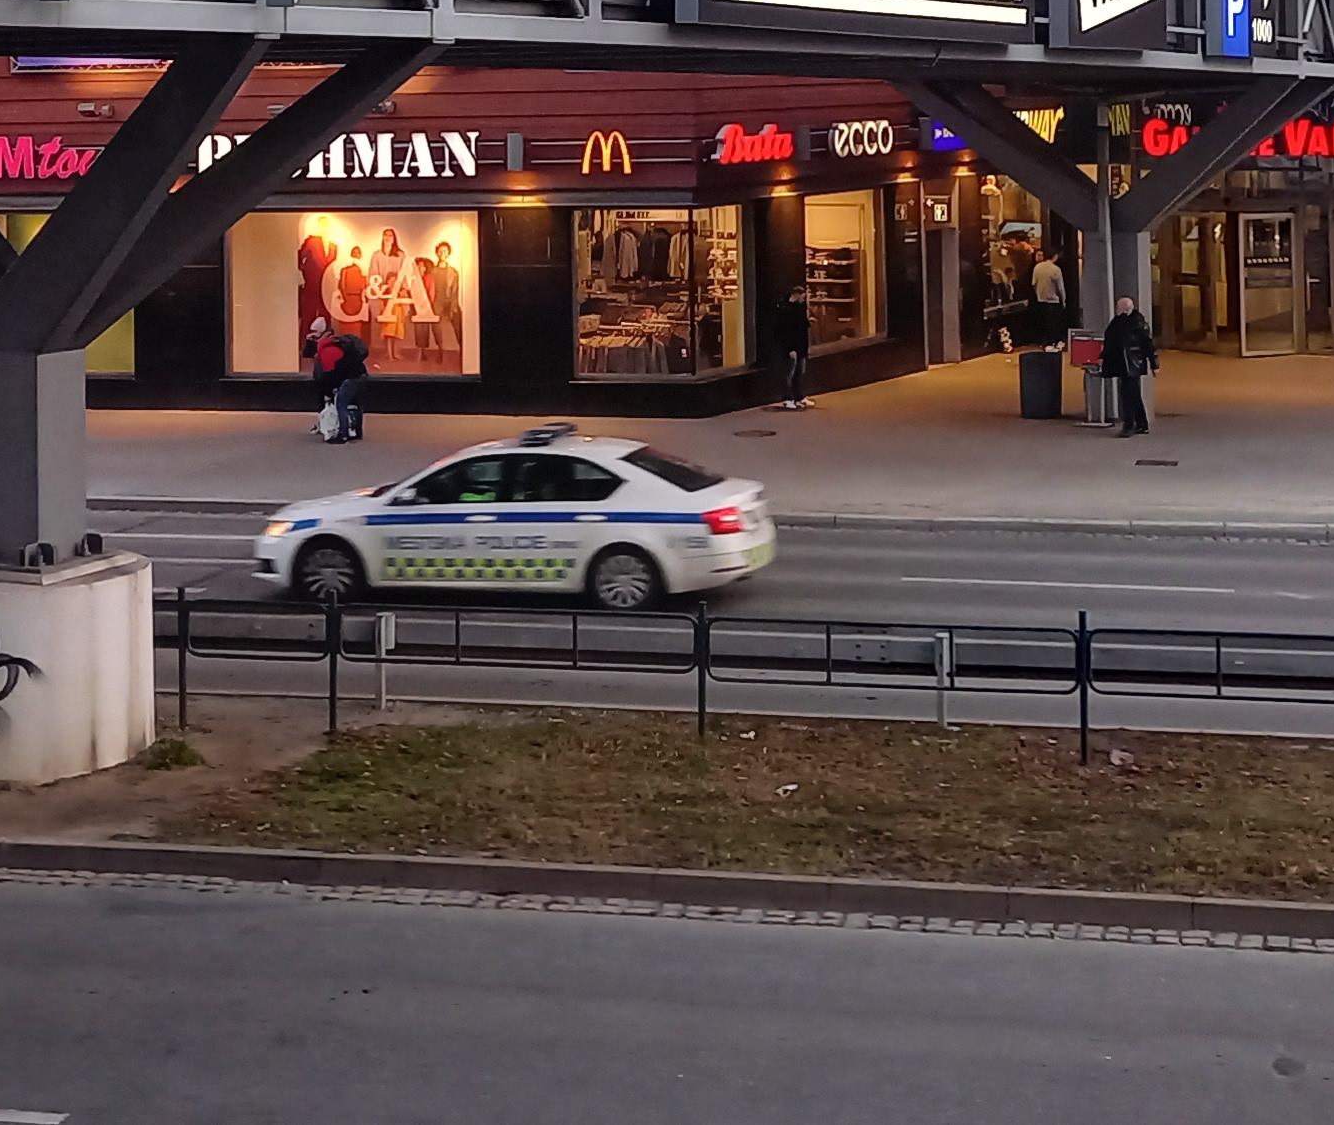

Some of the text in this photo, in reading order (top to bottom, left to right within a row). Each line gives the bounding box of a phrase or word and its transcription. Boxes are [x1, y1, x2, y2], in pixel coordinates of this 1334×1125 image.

[1251, 17, 1273, 43] 1000
[830, 120, 894, 158] ecco
[321, 252, 440, 323] C&A
